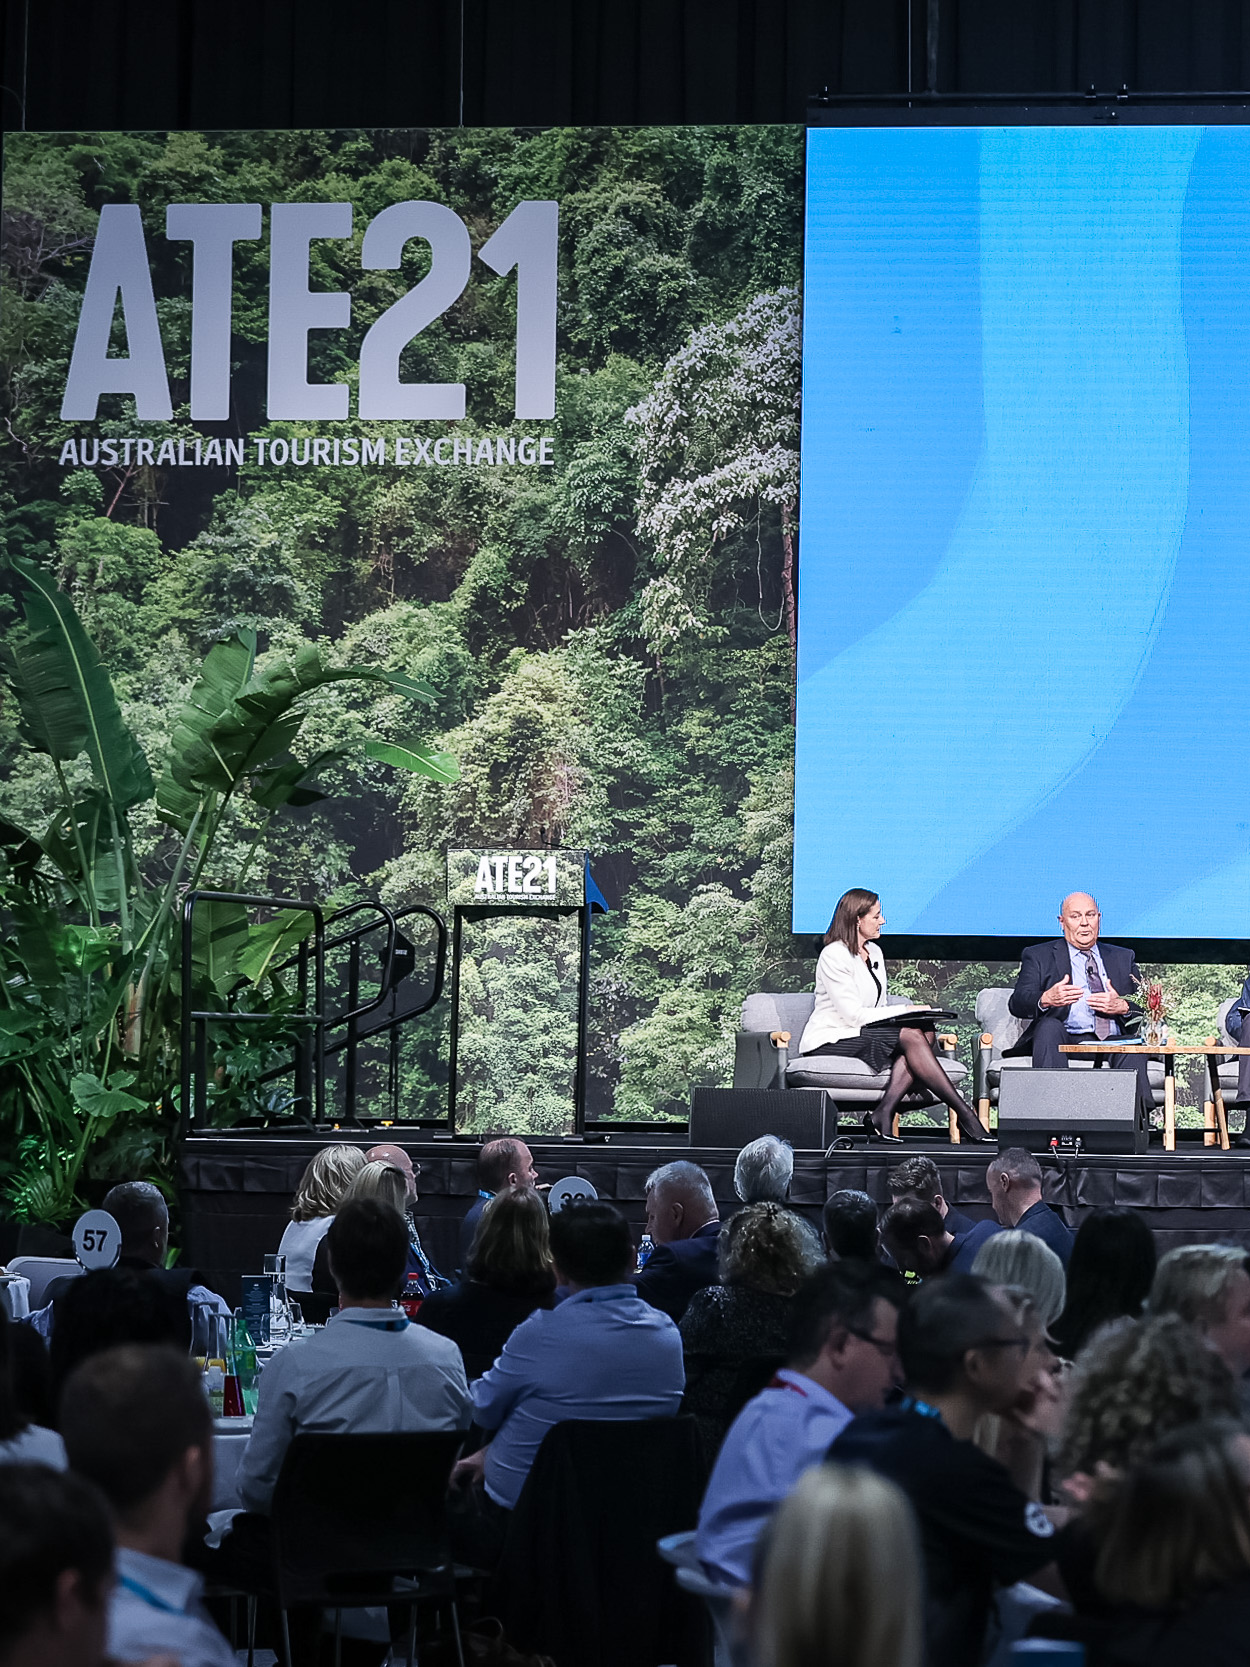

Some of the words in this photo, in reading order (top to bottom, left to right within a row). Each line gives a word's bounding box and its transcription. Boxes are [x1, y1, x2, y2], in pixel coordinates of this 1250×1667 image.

[60, 200, 559, 421] ATE21
[59, 437, 245, 467] AUSTRALIAN
[253, 437, 385, 467] TOURISM
[395, 437, 556, 467] EXCHANGE
[474, 855, 557, 893] ATE21
[82, 1229, 108, 1252] 57
